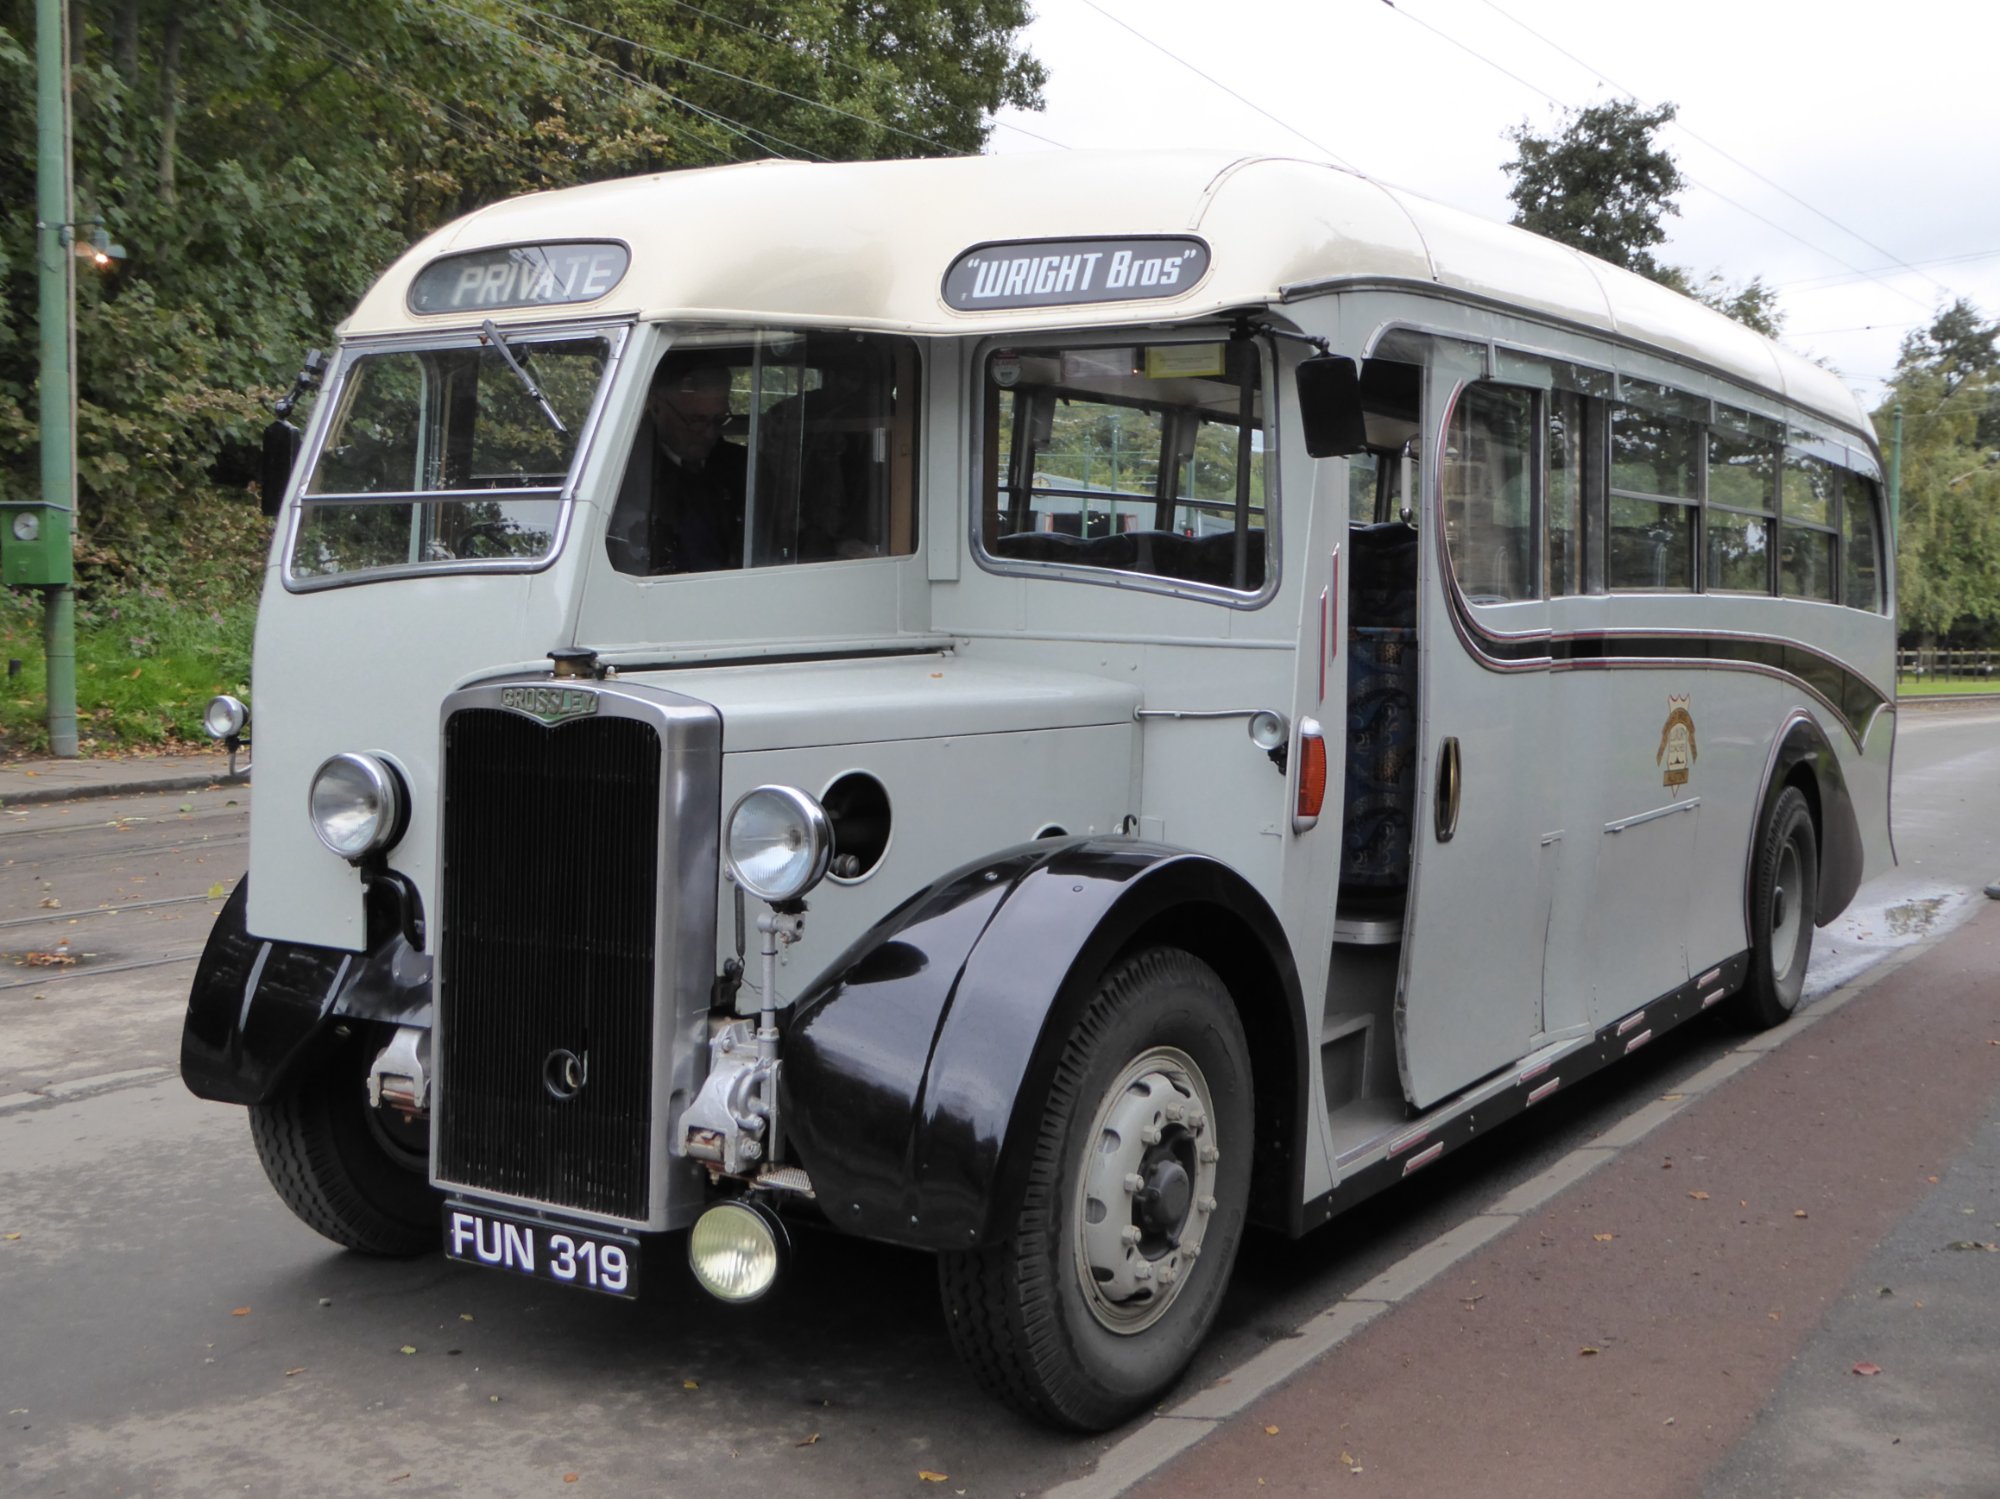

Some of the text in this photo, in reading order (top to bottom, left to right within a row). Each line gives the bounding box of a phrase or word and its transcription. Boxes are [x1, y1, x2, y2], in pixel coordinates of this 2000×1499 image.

[452, 253, 616, 306] PRIVATE
[502, 687, 598, 714] CROSSLEY
[452, 1212, 628, 1290] FUN 319
